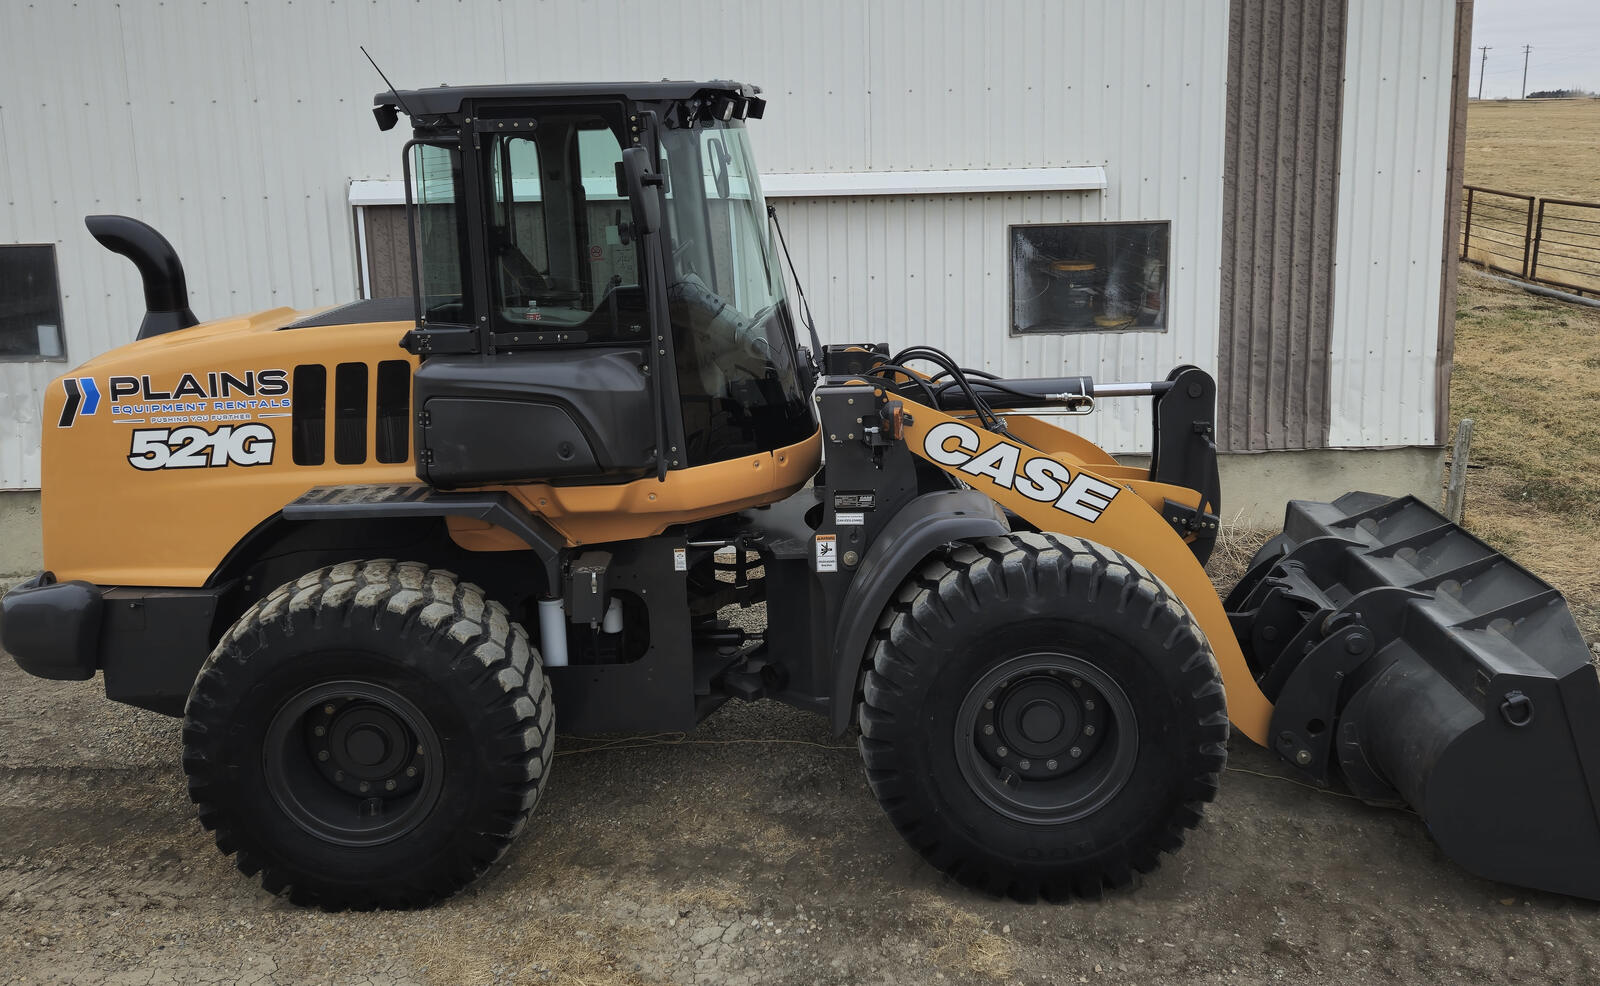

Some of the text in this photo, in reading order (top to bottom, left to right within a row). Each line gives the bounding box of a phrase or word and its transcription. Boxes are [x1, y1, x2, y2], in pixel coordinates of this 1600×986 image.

[110, 370, 289, 402] PLAINS
[112, 399, 291, 415] EQUIPMENT RENTALS
[211, 413, 251, 421] FURTHER
[127, 422, 276, 471] 521G
[923, 421, 1121, 523] CASE
